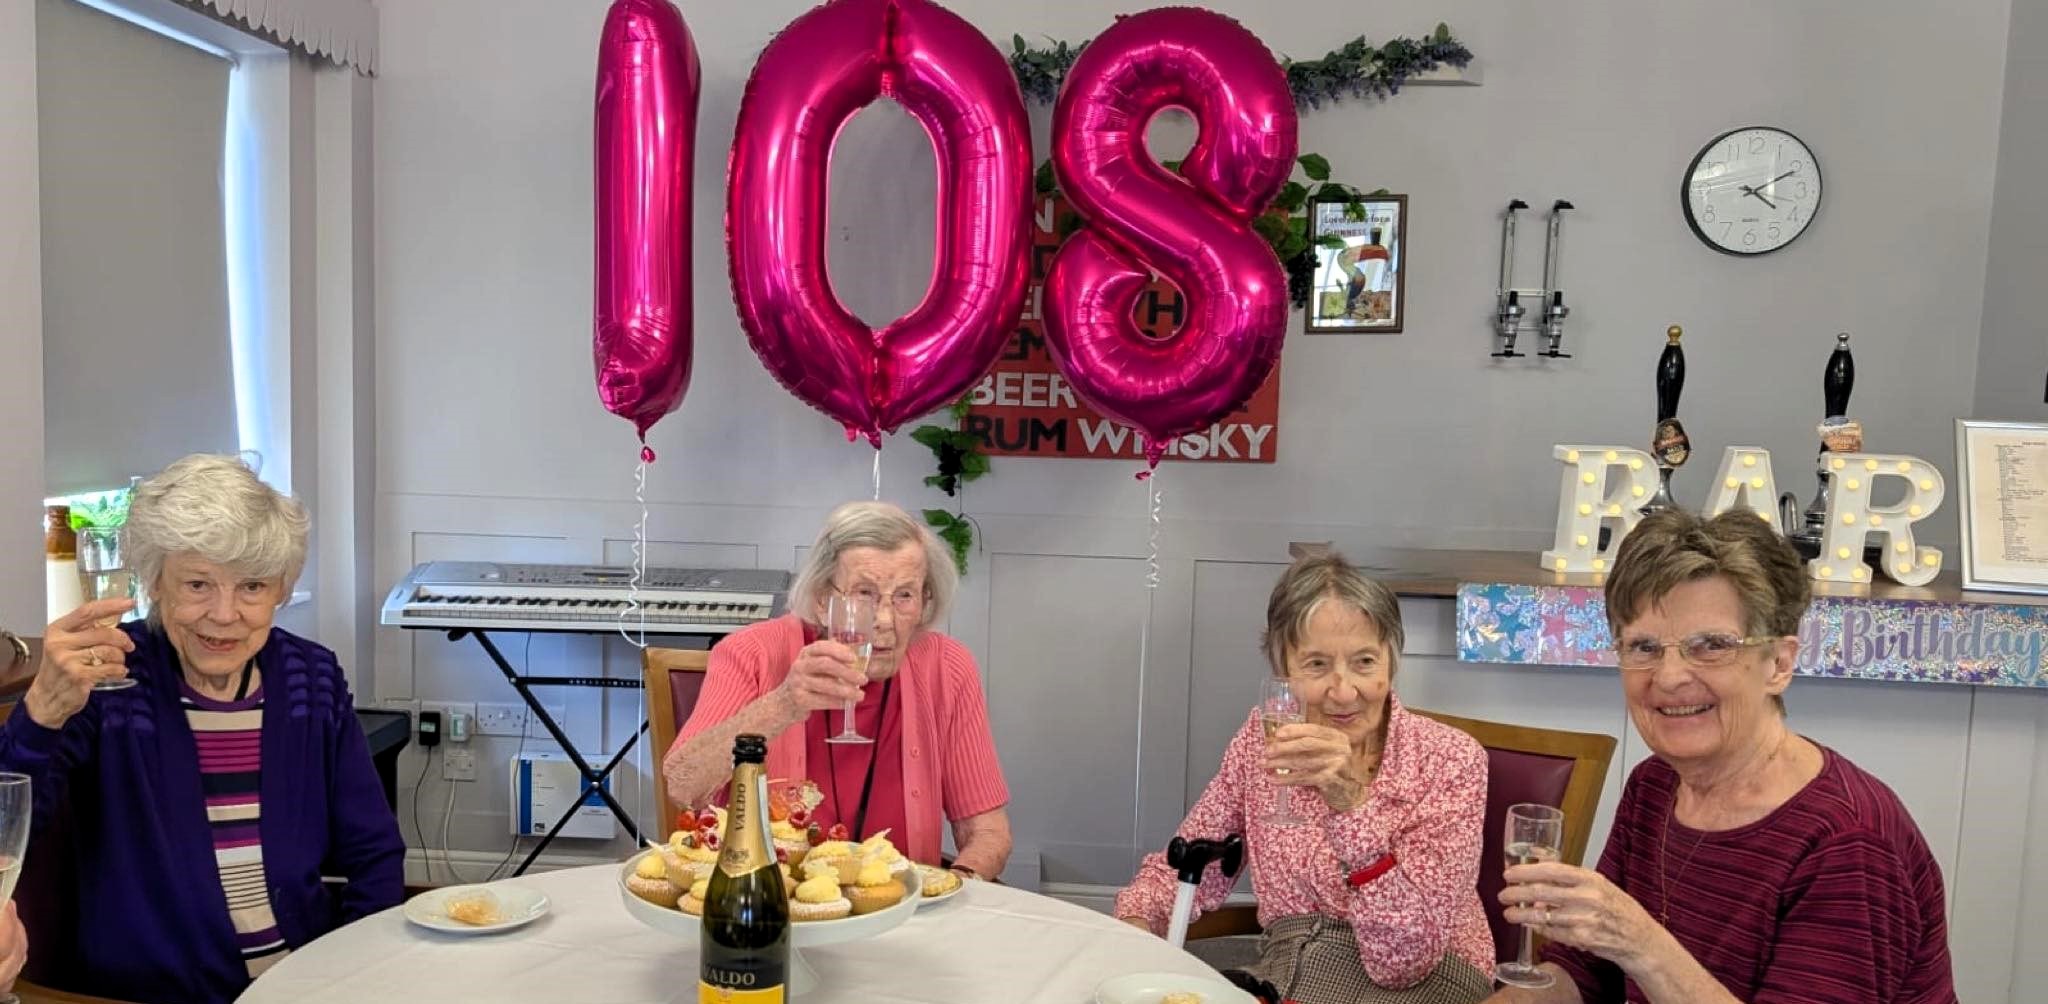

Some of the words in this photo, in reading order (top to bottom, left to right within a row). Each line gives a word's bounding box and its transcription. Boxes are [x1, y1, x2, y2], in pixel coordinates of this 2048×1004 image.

[1748, 136, 1766, 155] 12
[1794, 181, 1807, 200] 3
[594, 0, 1297, 446] 108
[1702, 204, 1715, 224] 8
[1719, 221, 1733, 242] 7
[1742, 228, 1757, 246] 6
[1767, 221, 1781, 241] 5
[970, 371, 1078, 409] BEER
[967, 414, 1068, 452] RUM
[1541, 444, 1945, 587] BAR
[1841, 606, 2042, 680] Birthday
[703, 963, 756, 986] VALDO
